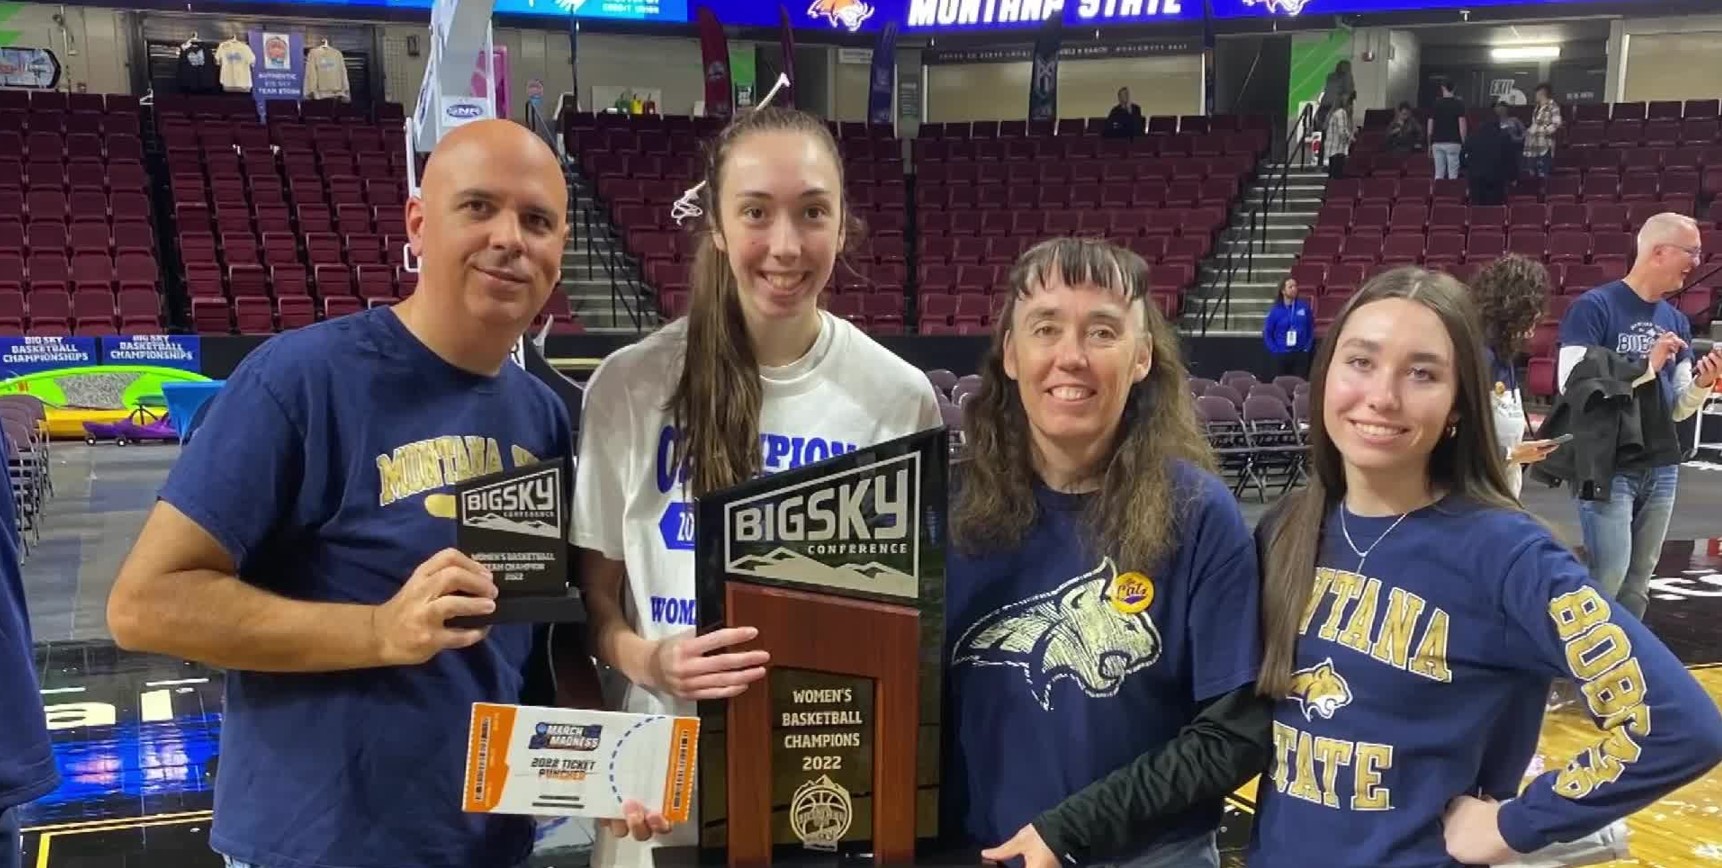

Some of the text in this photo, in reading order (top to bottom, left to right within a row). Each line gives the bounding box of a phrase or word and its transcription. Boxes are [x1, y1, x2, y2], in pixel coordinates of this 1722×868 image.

[908, 0, 1182, 26] MONTANA STATE
[24, 336, 63, 345] BIG SKY
[132, 334, 170, 342] BIG SKY
[11, 344, 78, 354] BASKETBALL
[119, 341, 183, 351] BASKETBALL
[3, 352, 89, 363] CHAMPIONSHIPS
[110, 350, 193, 360] CHAMPIONSHIPS
[376, 435, 504, 507] MONTANA
[807, 543, 908, 555] CONFERENCE
[507, 552, 556, 561] BASKETBALL
[793, 689, 852, 703] WOMEN'S
[782, 711, 862, 726] BASKETBALL
[547, 725, 585, 736] MARCH
[549, 736, 599, 748] MADNESS
[784, 733, 860, 748] CHAMPIONS
[561, 759, 597, 771] TICKET
[802, 756, 842, 770] 2022
[1271, 720, 1394, 810] TATE
[538, 768, 586, 780] PUNCHED
